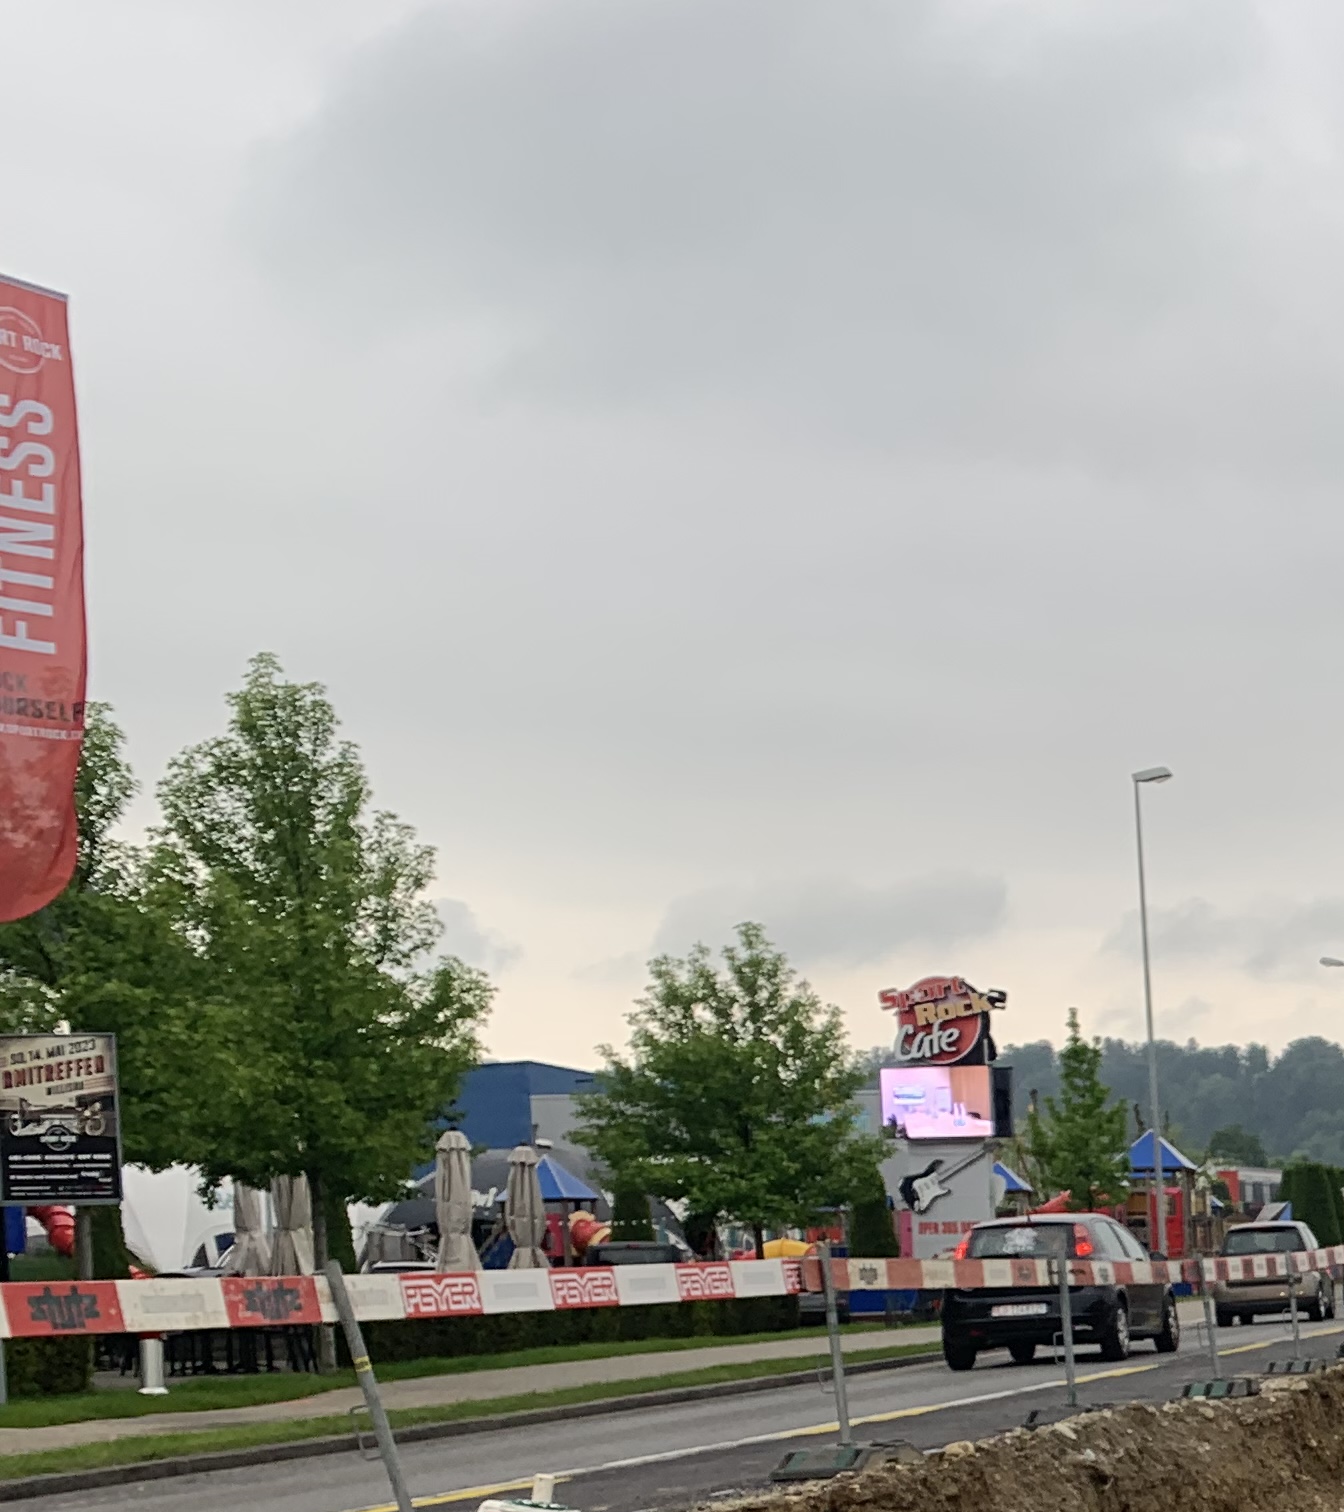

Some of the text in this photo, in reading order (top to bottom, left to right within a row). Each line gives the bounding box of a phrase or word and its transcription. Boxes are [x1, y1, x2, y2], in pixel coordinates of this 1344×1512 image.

[0, 394, 56, 655] FITNESS
[0, 695, 85, 722] URSELF
[877, 976, 965, 1012] Sport
[404, 1277, 481, 1312] PEYER
[553, 1272, 618, 1304] PEYER
[679, 1267, 733, 1296] PEYER
